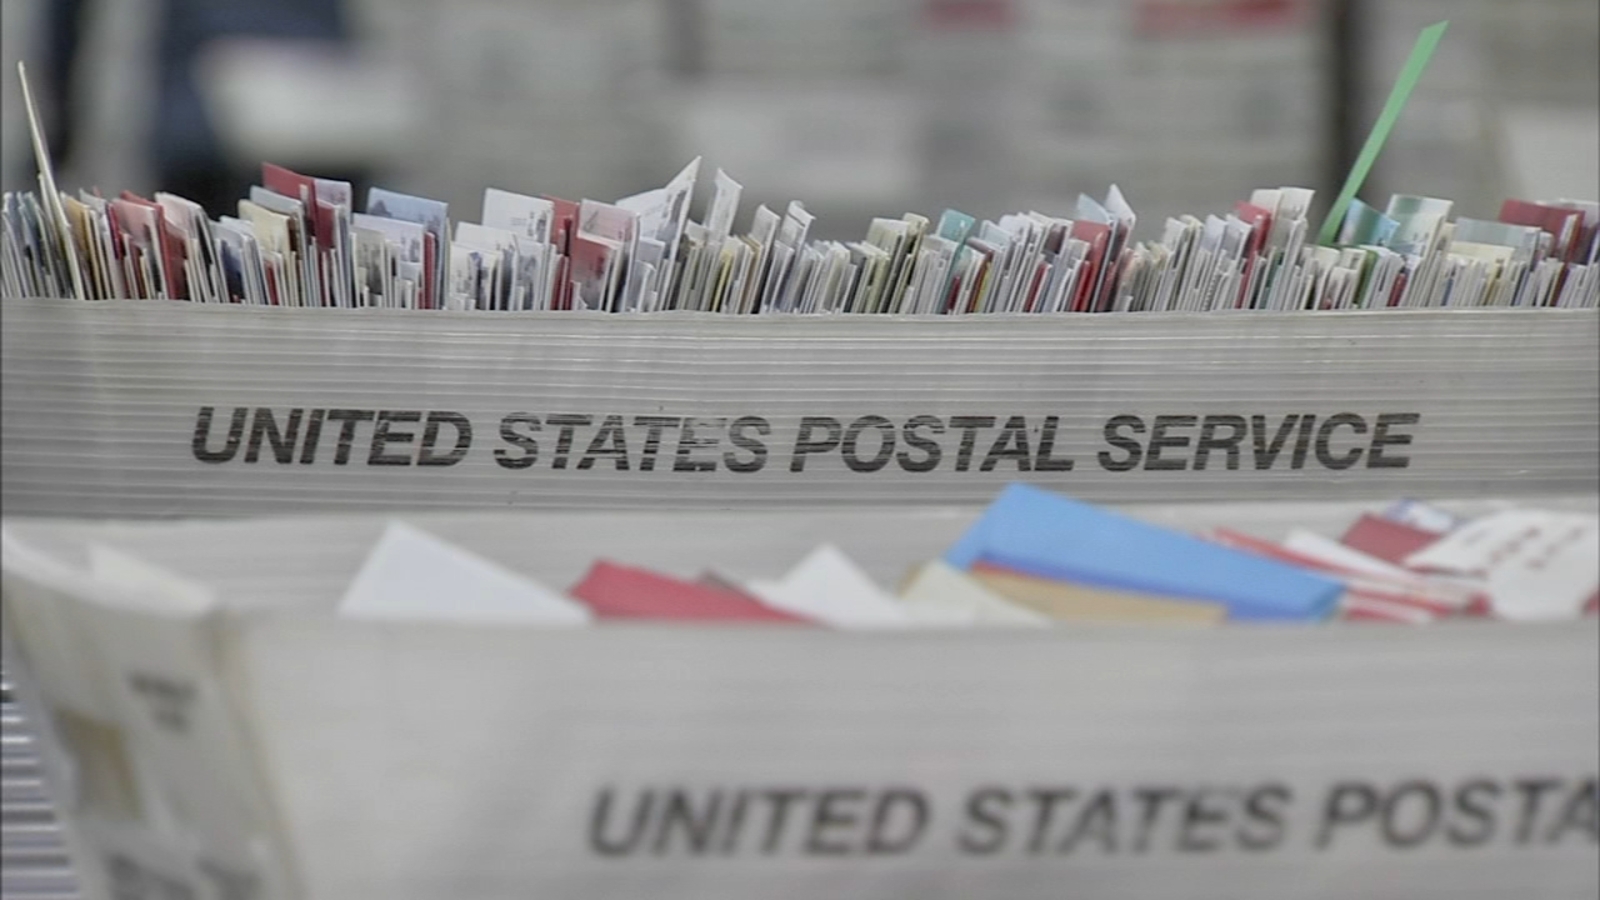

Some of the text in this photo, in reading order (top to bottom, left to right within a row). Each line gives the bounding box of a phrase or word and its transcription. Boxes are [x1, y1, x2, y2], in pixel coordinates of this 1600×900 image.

[191, 406, 1420, 473] UNITED STATES POSTAL SERVICE
[589, 779, 1599, 857] UNITED STATES POSTA
